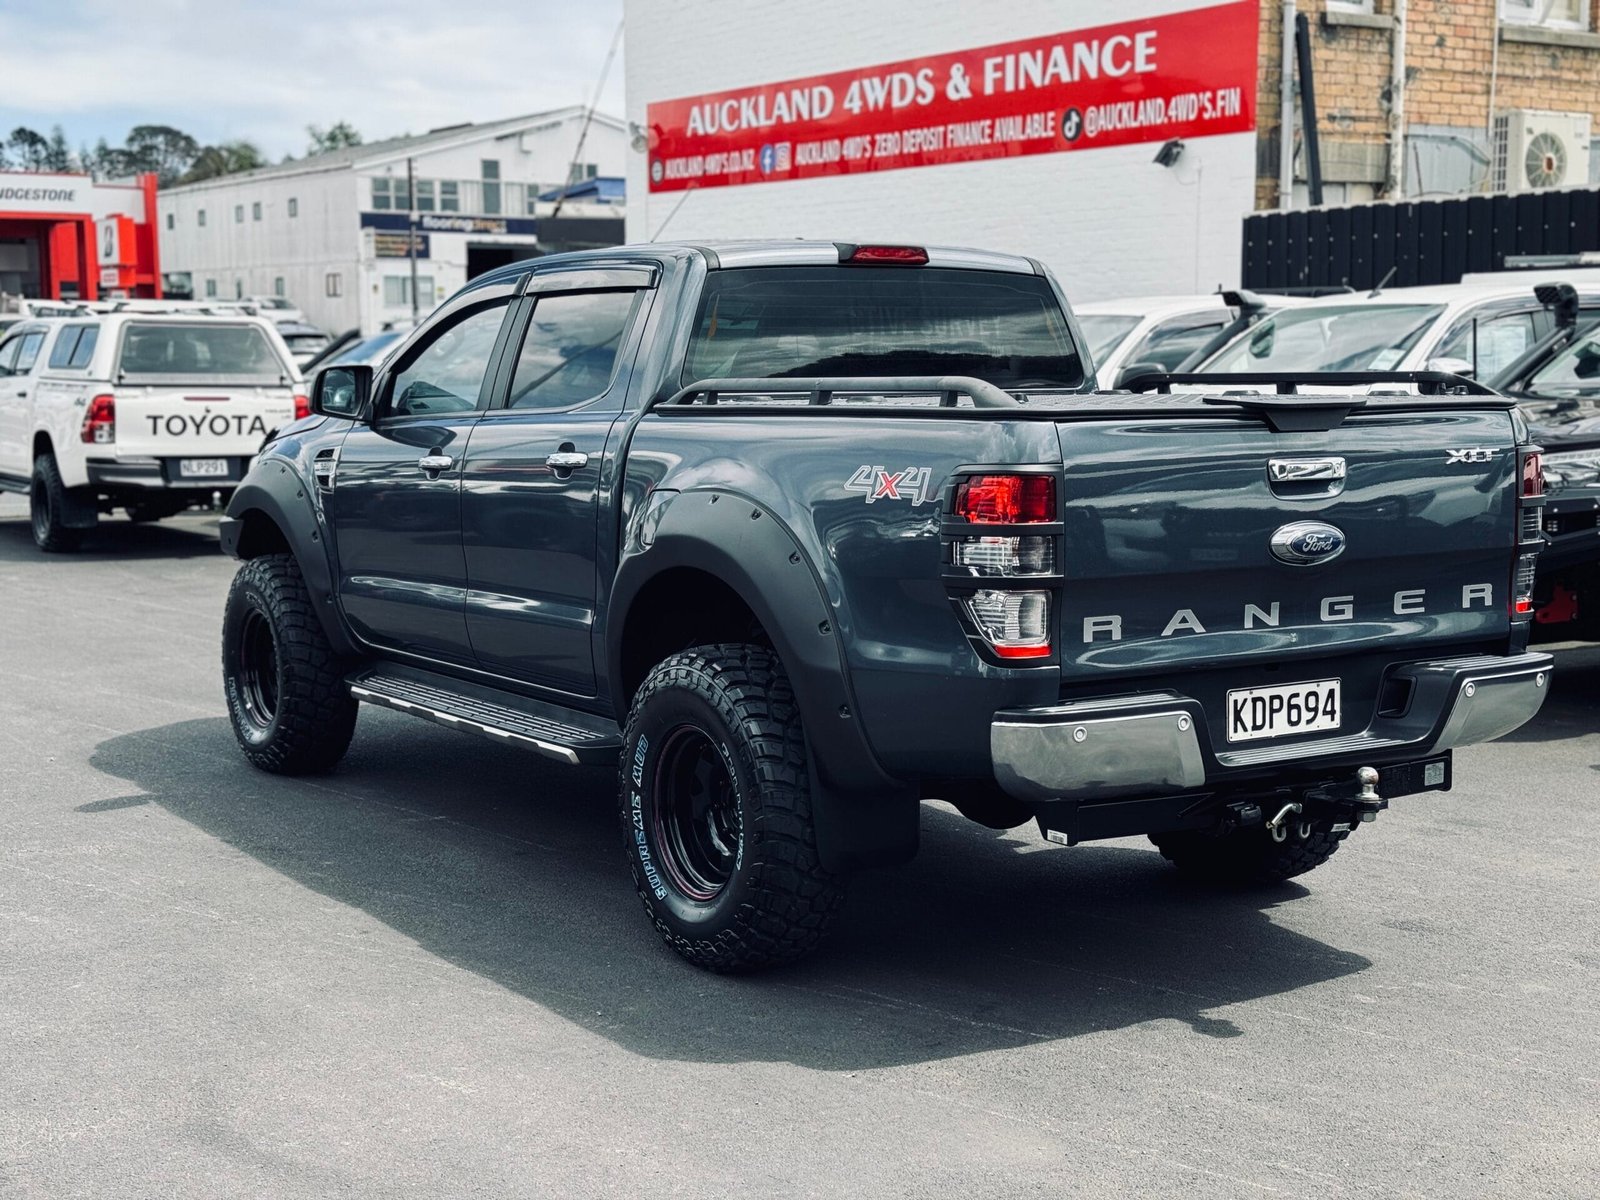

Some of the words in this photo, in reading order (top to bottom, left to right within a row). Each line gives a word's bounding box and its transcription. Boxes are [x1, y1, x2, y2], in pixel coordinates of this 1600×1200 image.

[686, 85, 834, 137] AUCKLAND
[843, 67, 935, 114] 4WDS
[945, 62, 973, 101] &
[983, 30, 1158, 96] FINANCE
[795, 139, 841, 166] AUCKLAND
[874, 129, 900, 157] ZERO
[902, 125, 945, 153] DEPOSIT
[946, 119, 992, 148] FINANCE
[993, 111, 1056, 142] AVAILABLE
[146, 414, 268, 437] TOYOTA
[1302, 533, 1334, 552] Ford
[1083, 583, 1493, 643] RANGER
[1233, 688, 1337, 734] KDP694
